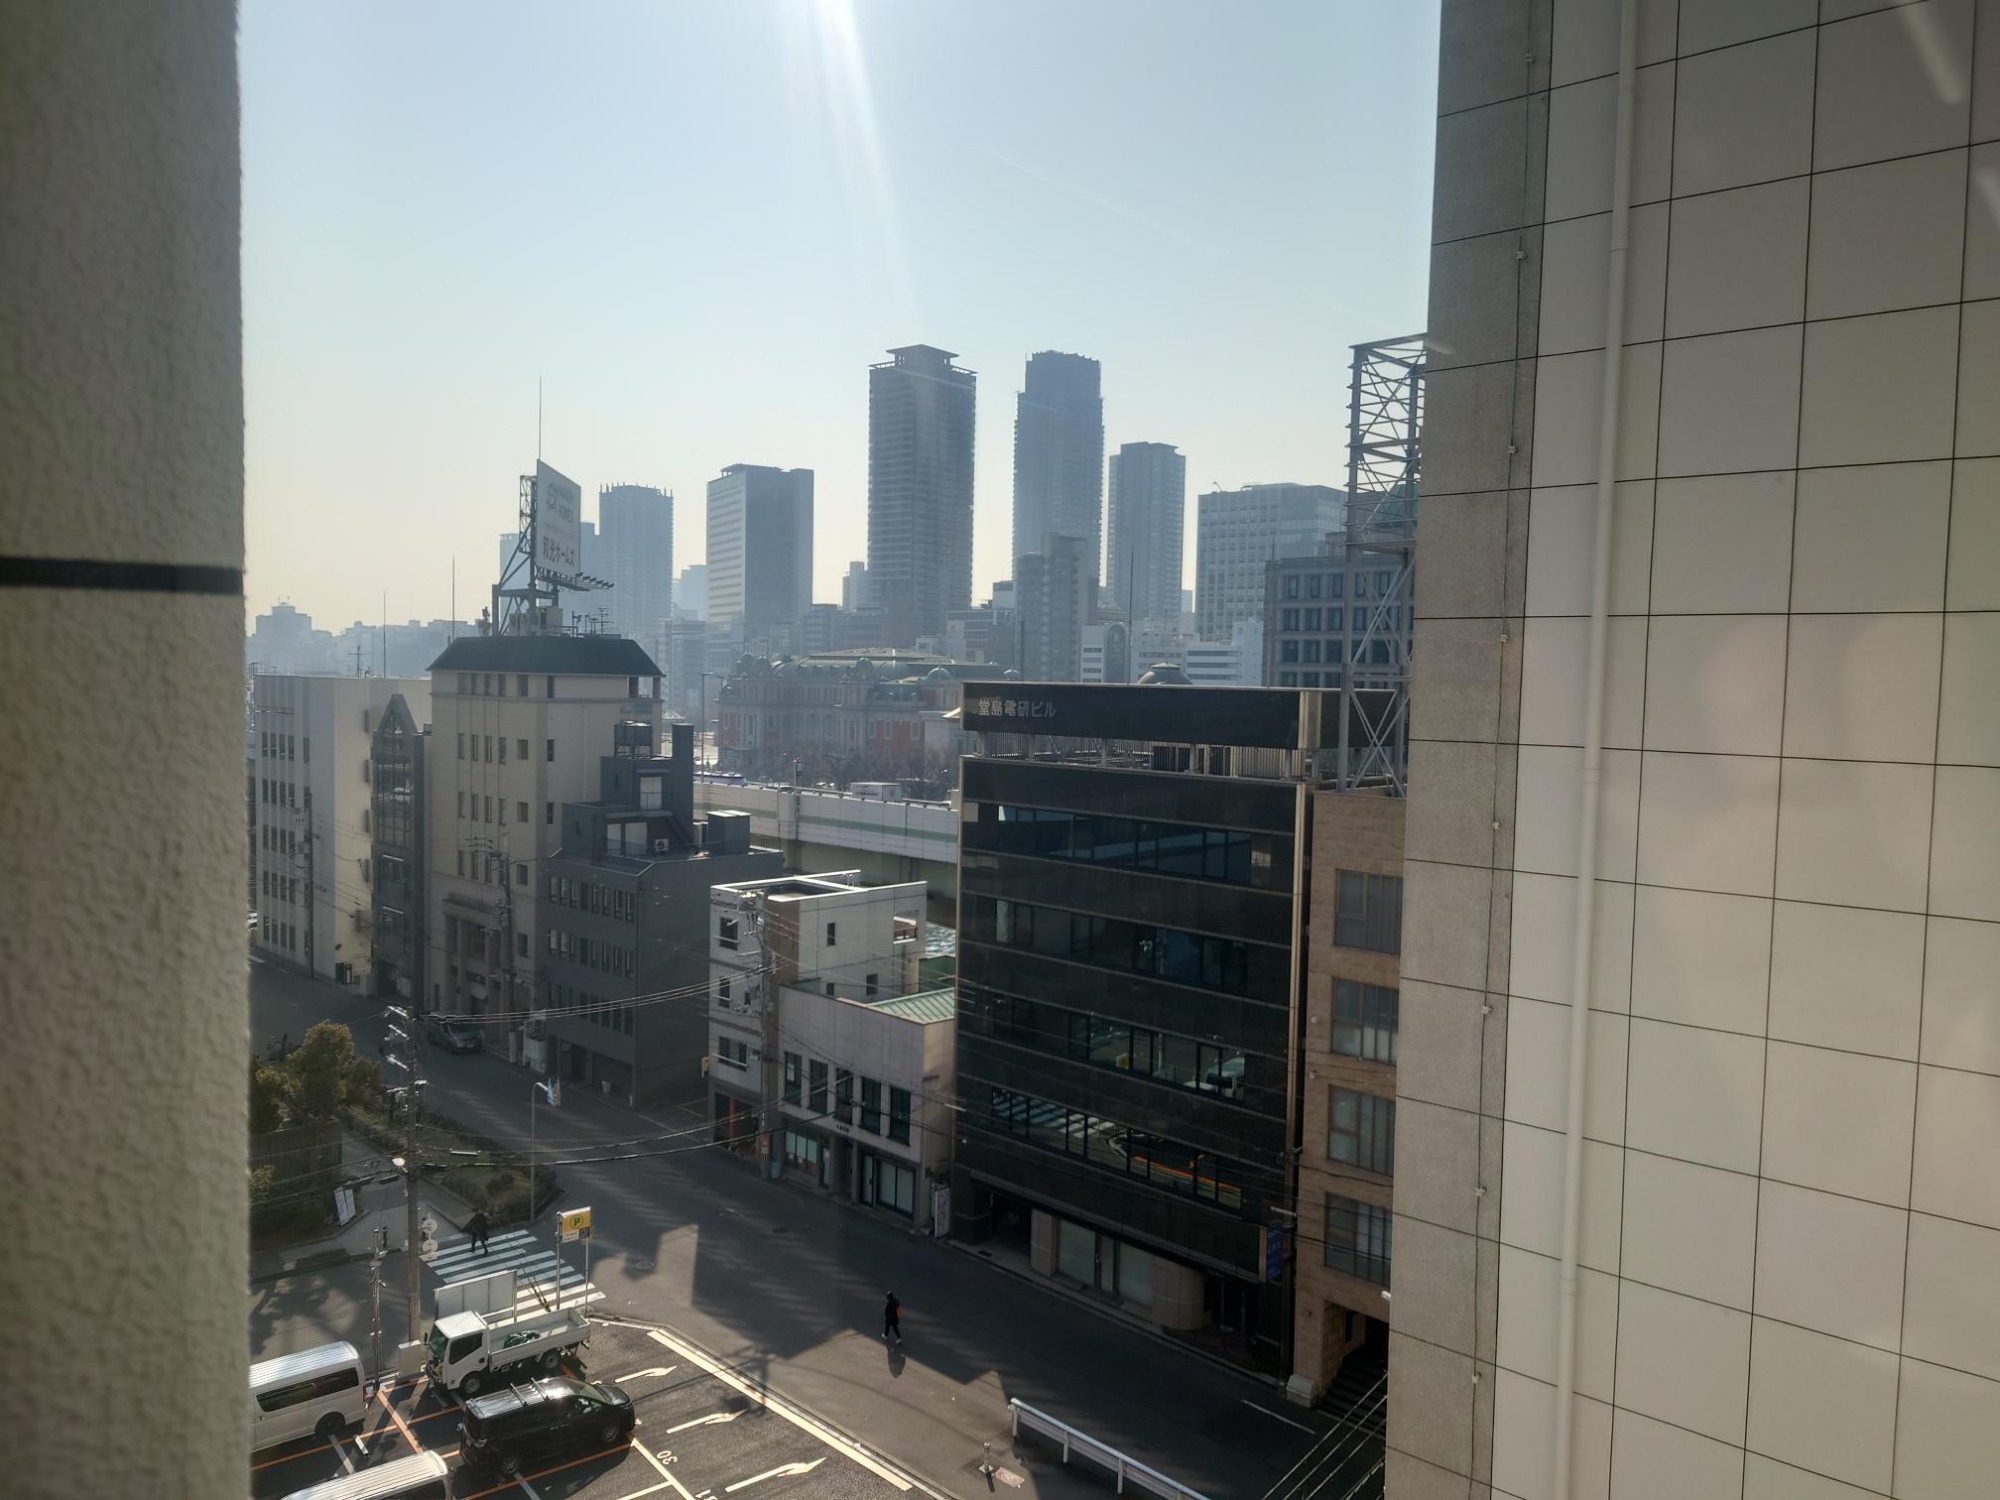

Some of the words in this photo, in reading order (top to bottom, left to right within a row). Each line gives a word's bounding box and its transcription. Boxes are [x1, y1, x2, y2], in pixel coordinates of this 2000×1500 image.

[978, 698, 1057, 718] 堂島電研ビル
[573, 1216, 581, 1226] P
[656, 1450, 678, 1465] 30
